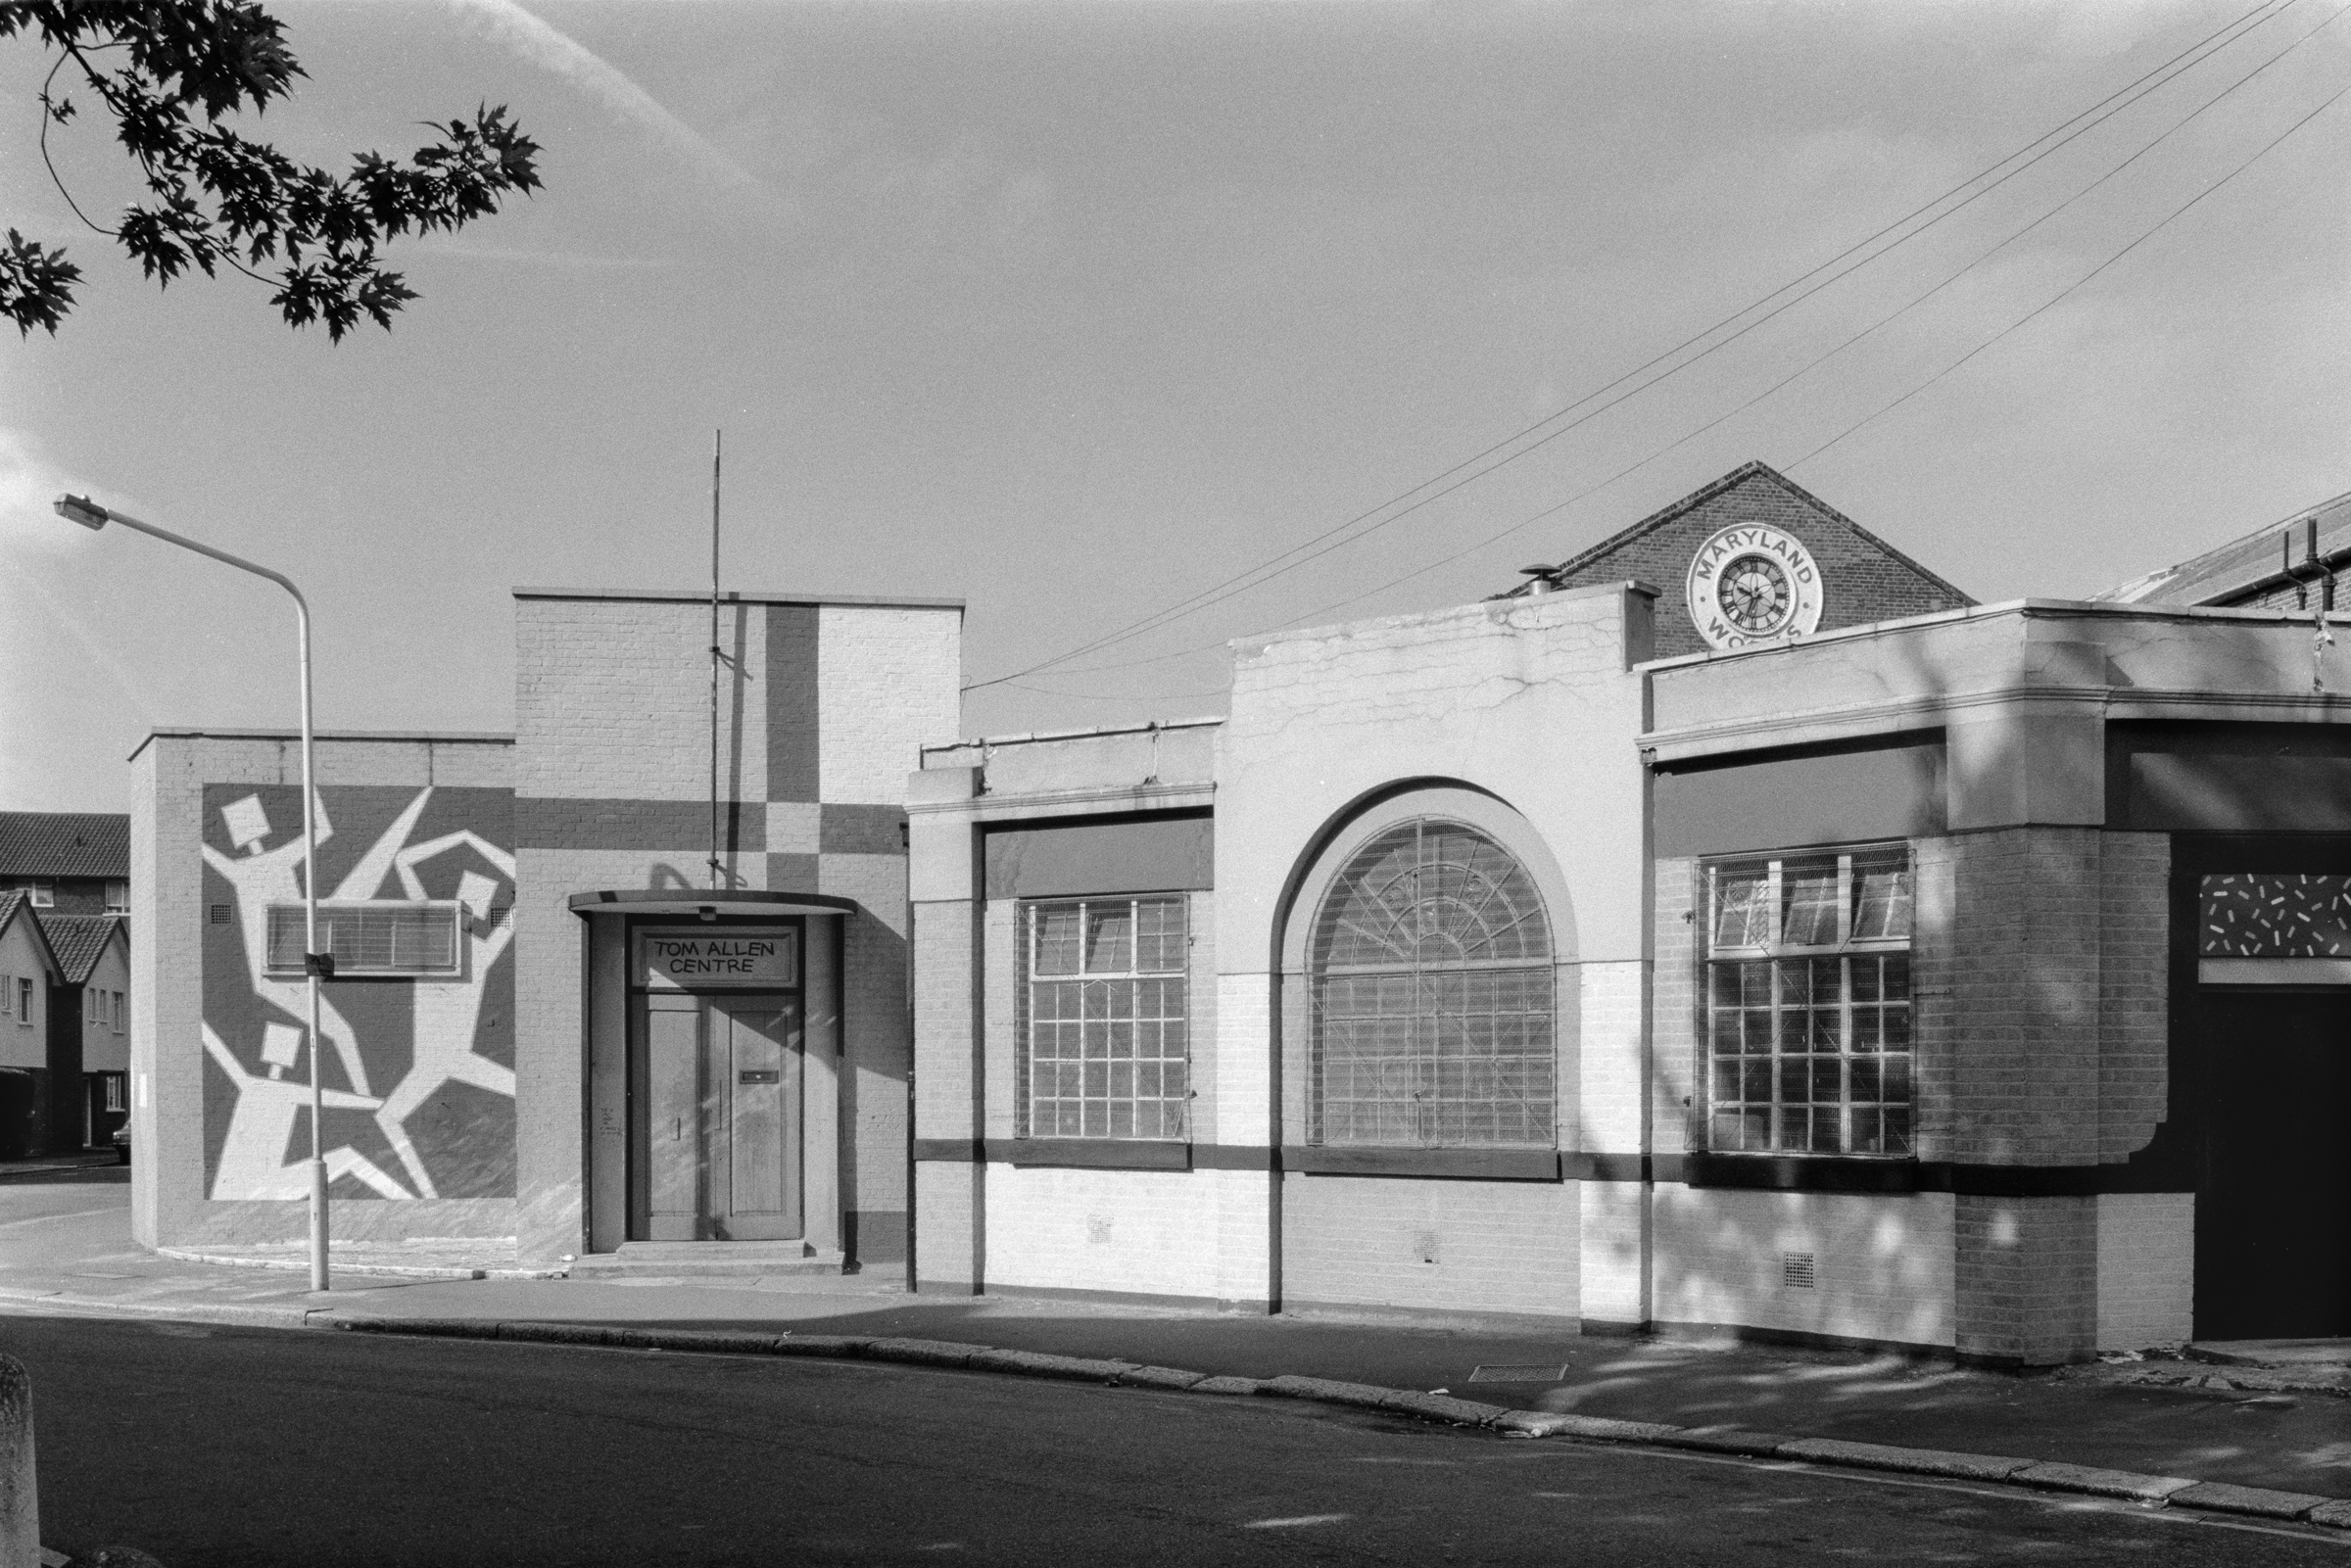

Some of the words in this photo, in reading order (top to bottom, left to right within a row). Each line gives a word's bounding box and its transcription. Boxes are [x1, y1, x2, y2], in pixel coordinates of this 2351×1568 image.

[1696, 530, 1813, 584] MARYLAND
[1708, 615, 1802, 648] WOS
[654, 941, 699, 957] TOM
[707, 941, 775, 957] ALLEN
[670, 958, 754, 974] CENTRE
